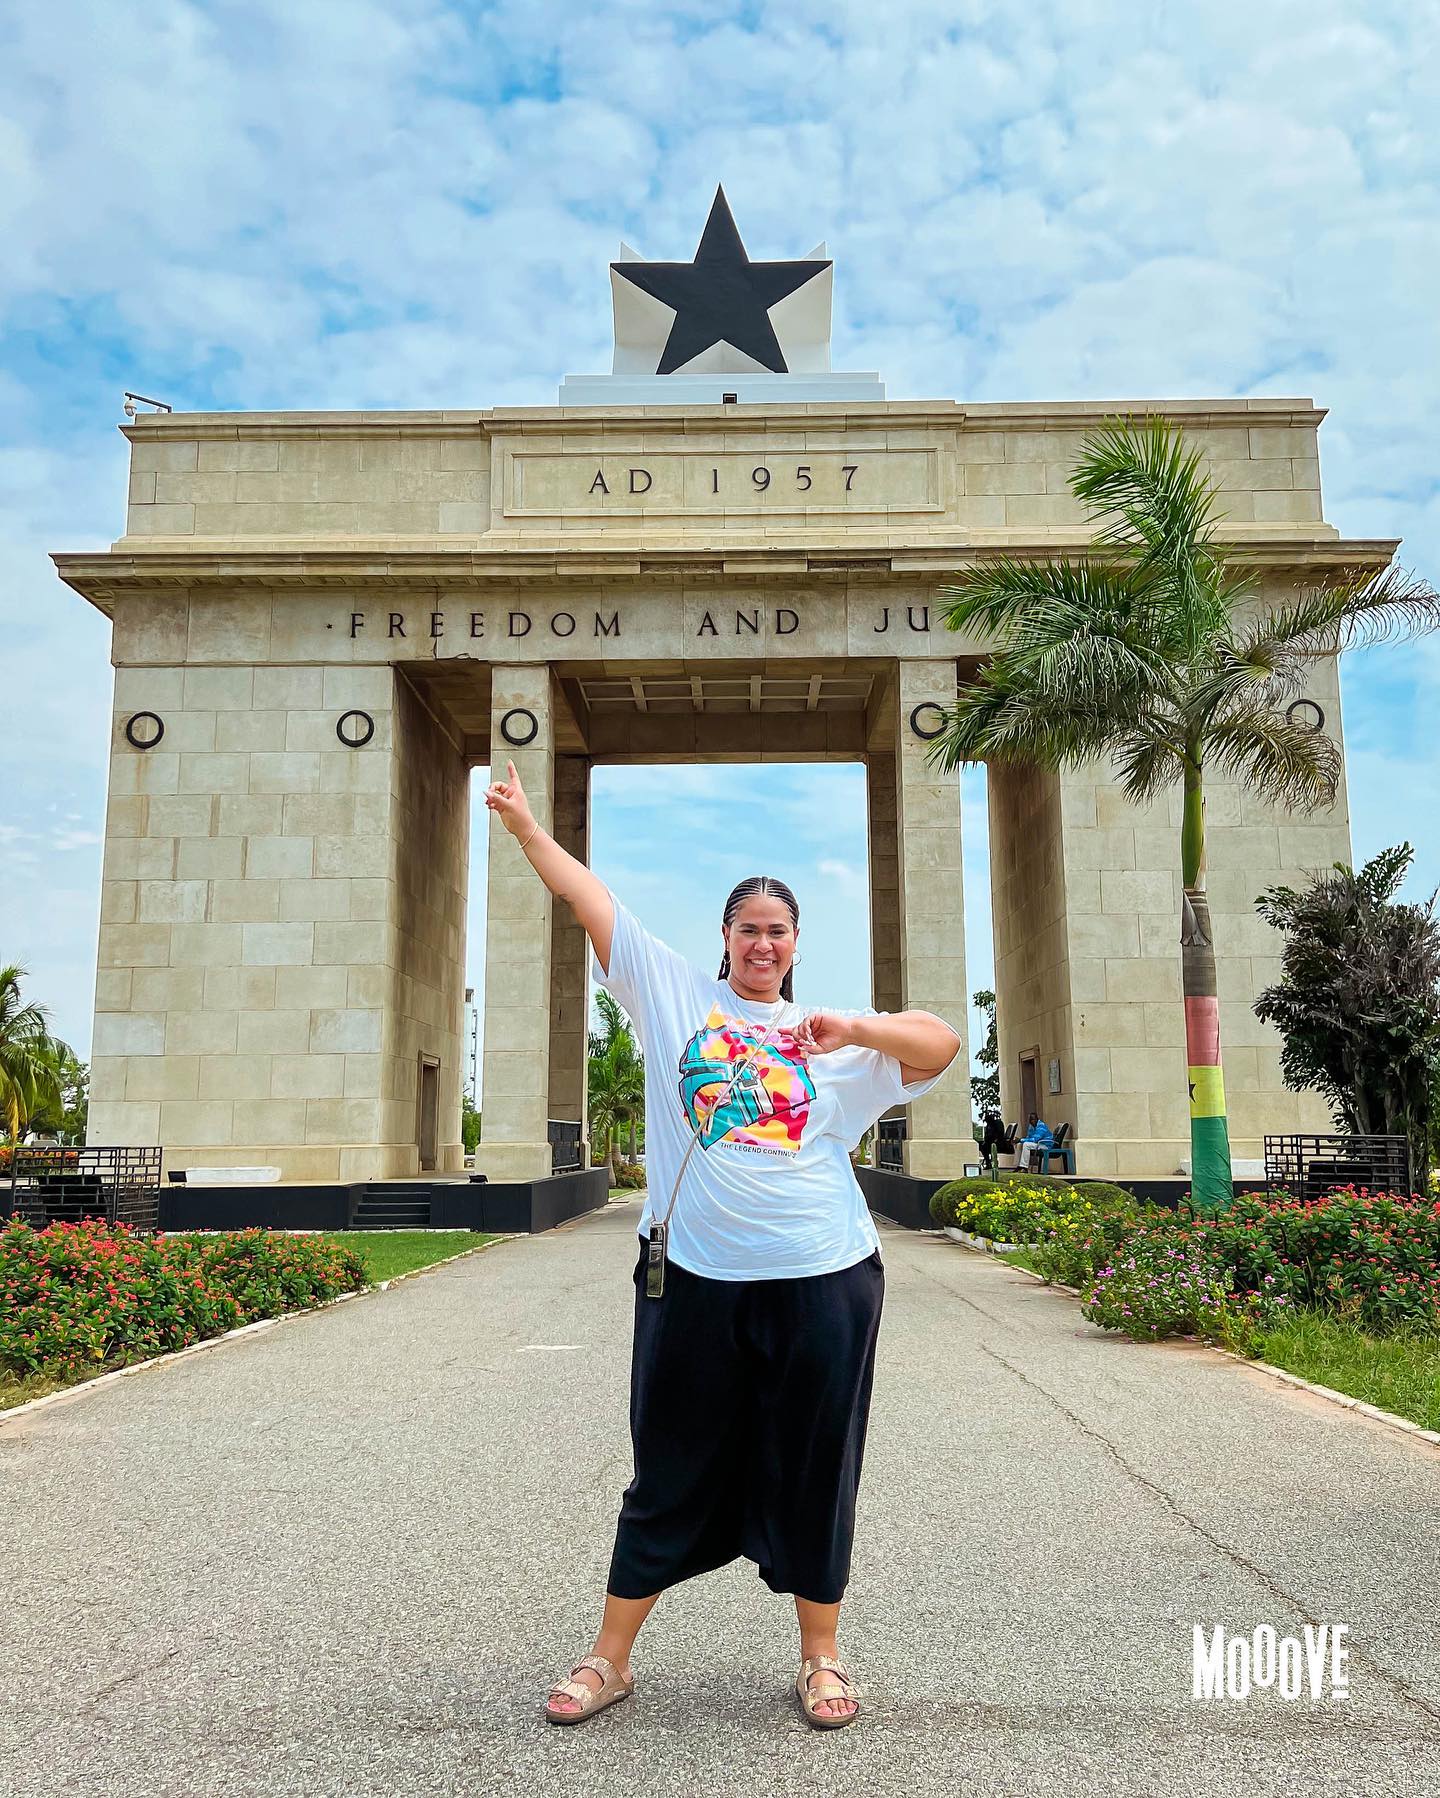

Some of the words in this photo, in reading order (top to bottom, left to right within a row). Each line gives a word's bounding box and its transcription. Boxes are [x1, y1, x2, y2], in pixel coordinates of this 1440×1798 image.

[588, 469, 653, 494] AD
[712, 466, 859, 494] 1957
[350, 610, 621, 639] FREEDOM
[696, 609, 800, 637] AND
[720, 1142, 733, 1150] THE
[734, 1145, 762, 1154] LEGEND
